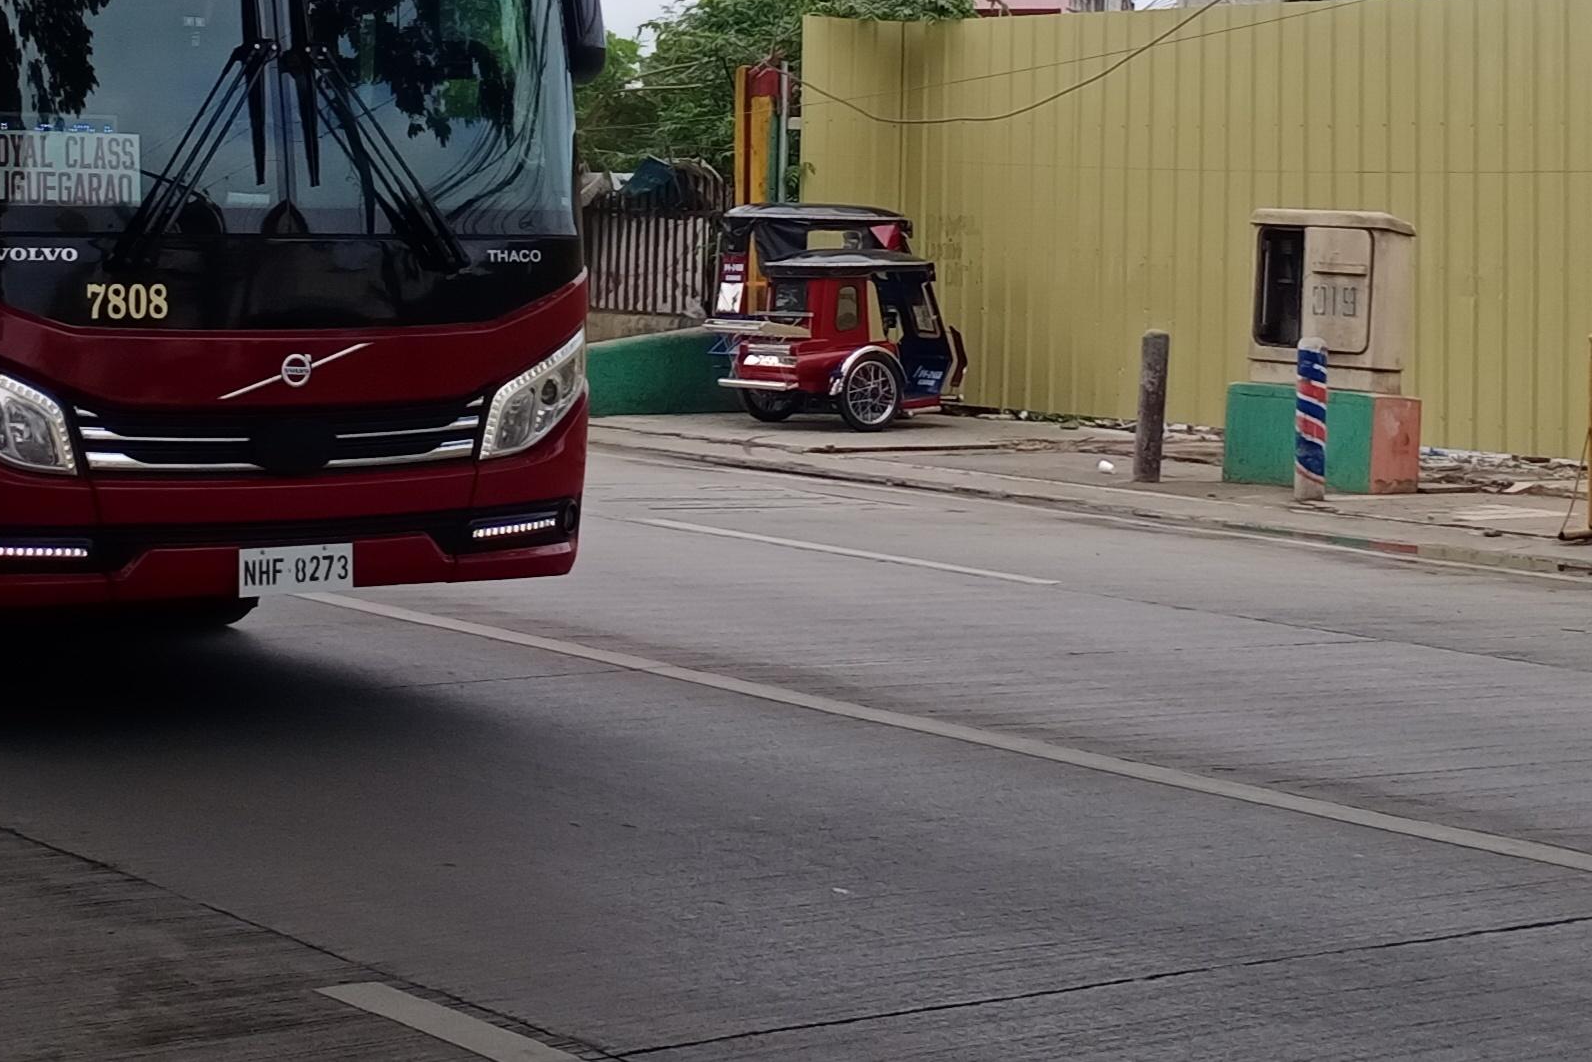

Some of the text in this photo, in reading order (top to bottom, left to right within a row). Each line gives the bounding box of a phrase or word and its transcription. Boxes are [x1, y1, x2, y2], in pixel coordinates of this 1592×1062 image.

[65, 135, 136, 171] CLASS
[487, 249, 542, 263] THACO
[87, 283, 168, 319] 7808
[244, 555, 349, 586] NHF 8273
